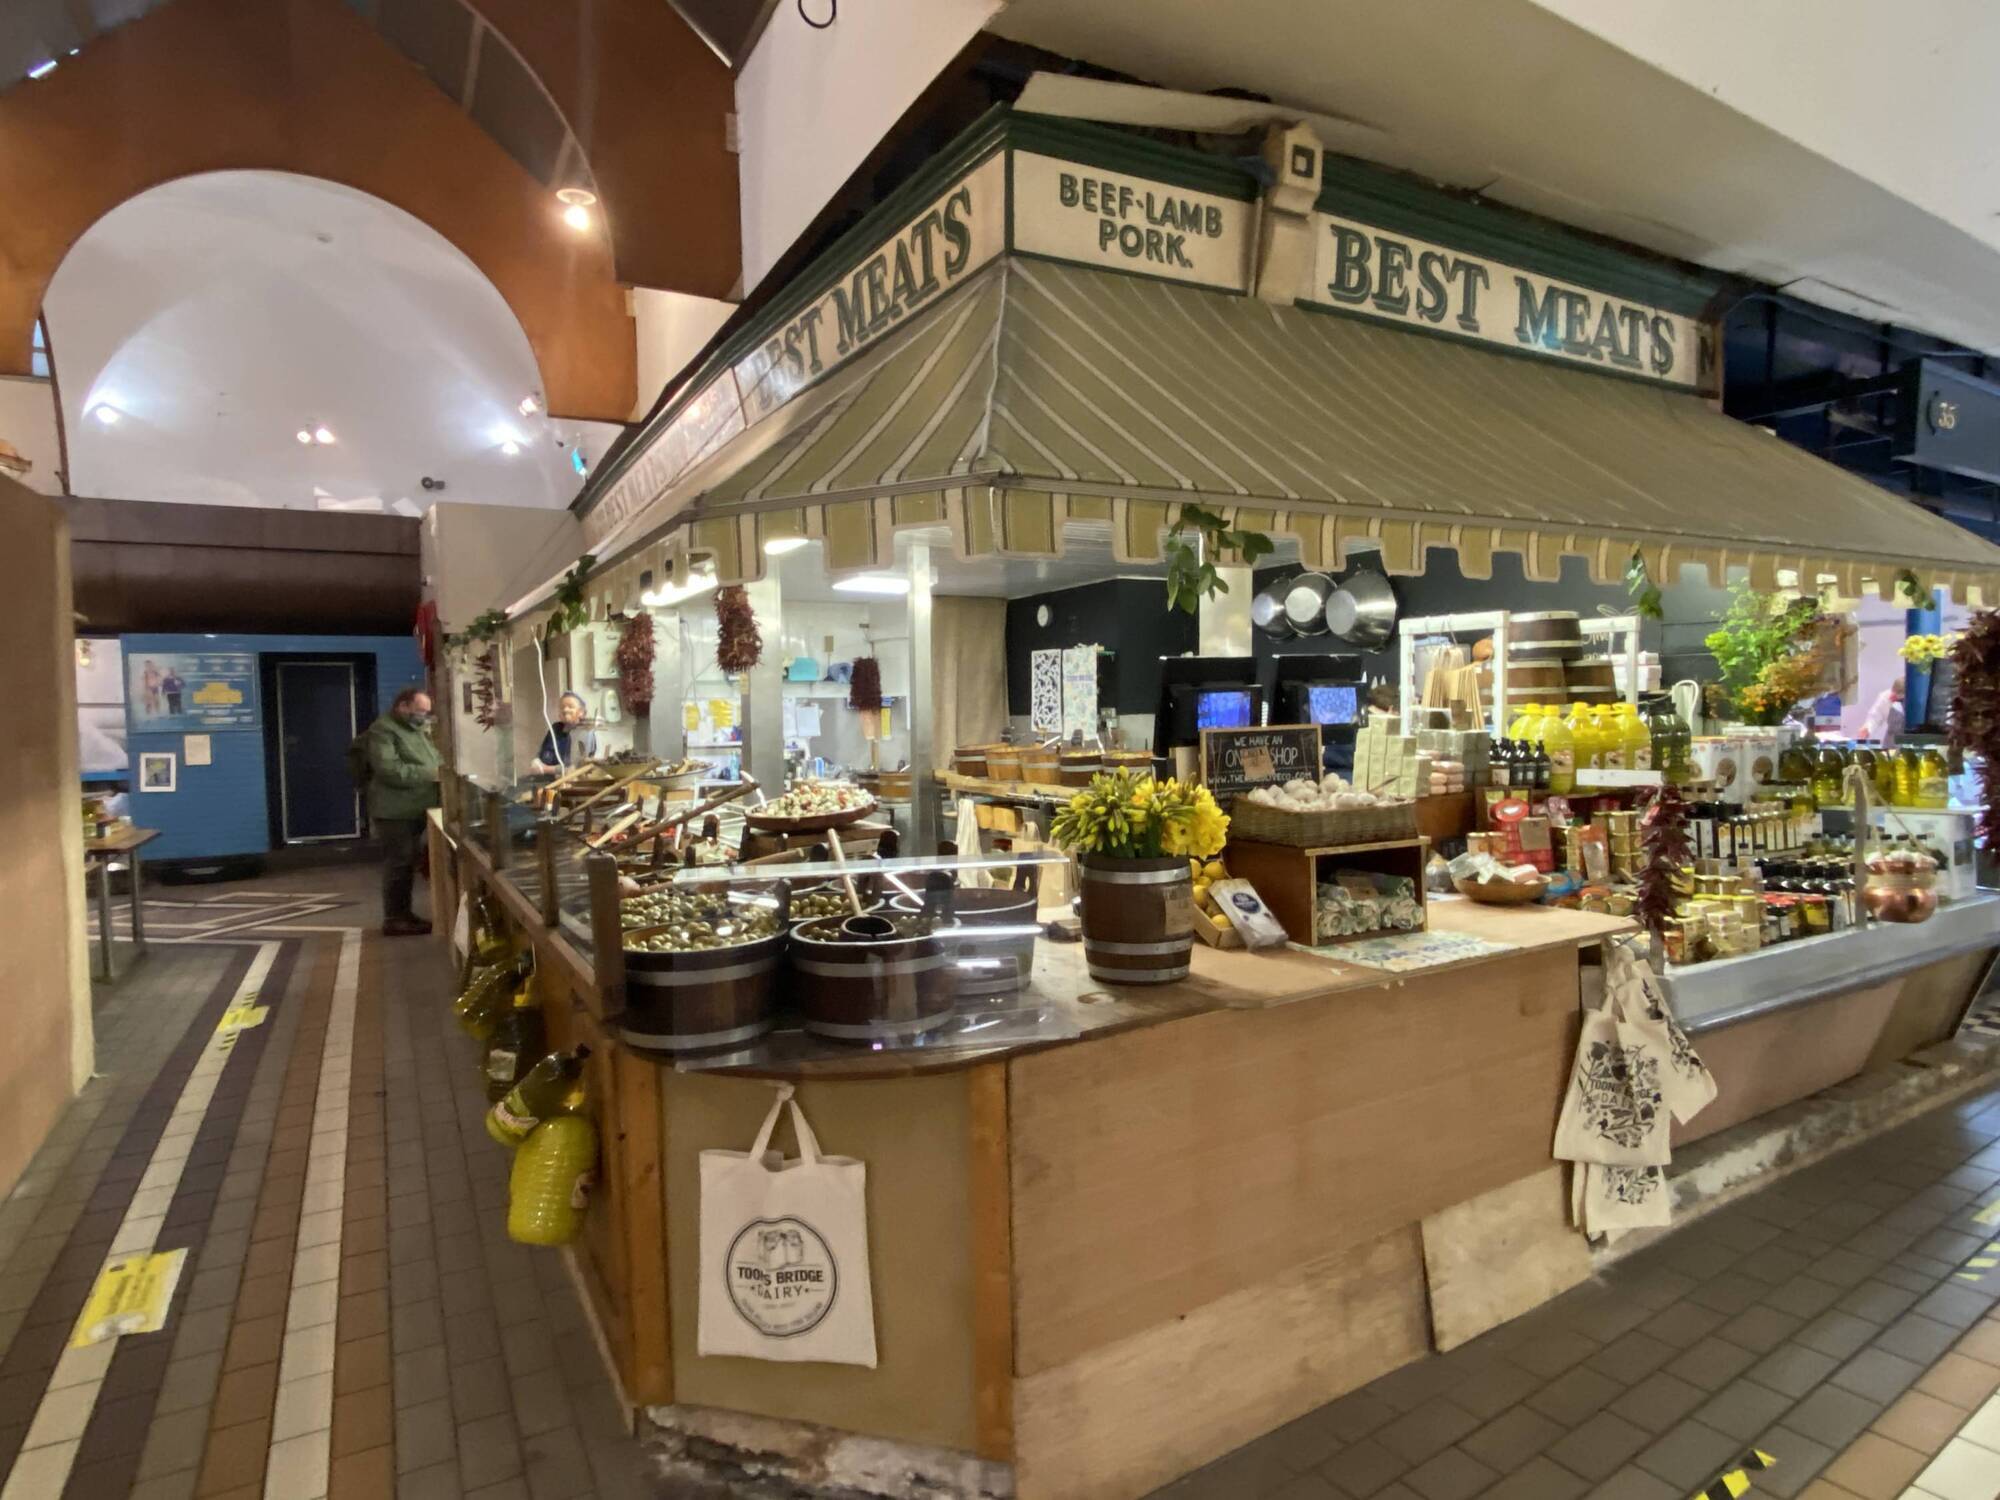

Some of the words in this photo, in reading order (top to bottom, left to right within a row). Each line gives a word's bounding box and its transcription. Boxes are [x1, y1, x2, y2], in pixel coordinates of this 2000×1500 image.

[830, 185, 972, 354] MEATS
[1327, 224, 1491, 333] BEST
[1513, 275, 1676, 377] MEATS
[1234, 736, 1247, 746] WE
[1249, 735, 1270, 746] HAVE
[1272, 735, 1283, 745] AN
[1271, 747, 1298, 765] SHOP
[777, 1270, 823, 1284] BRIDGE
